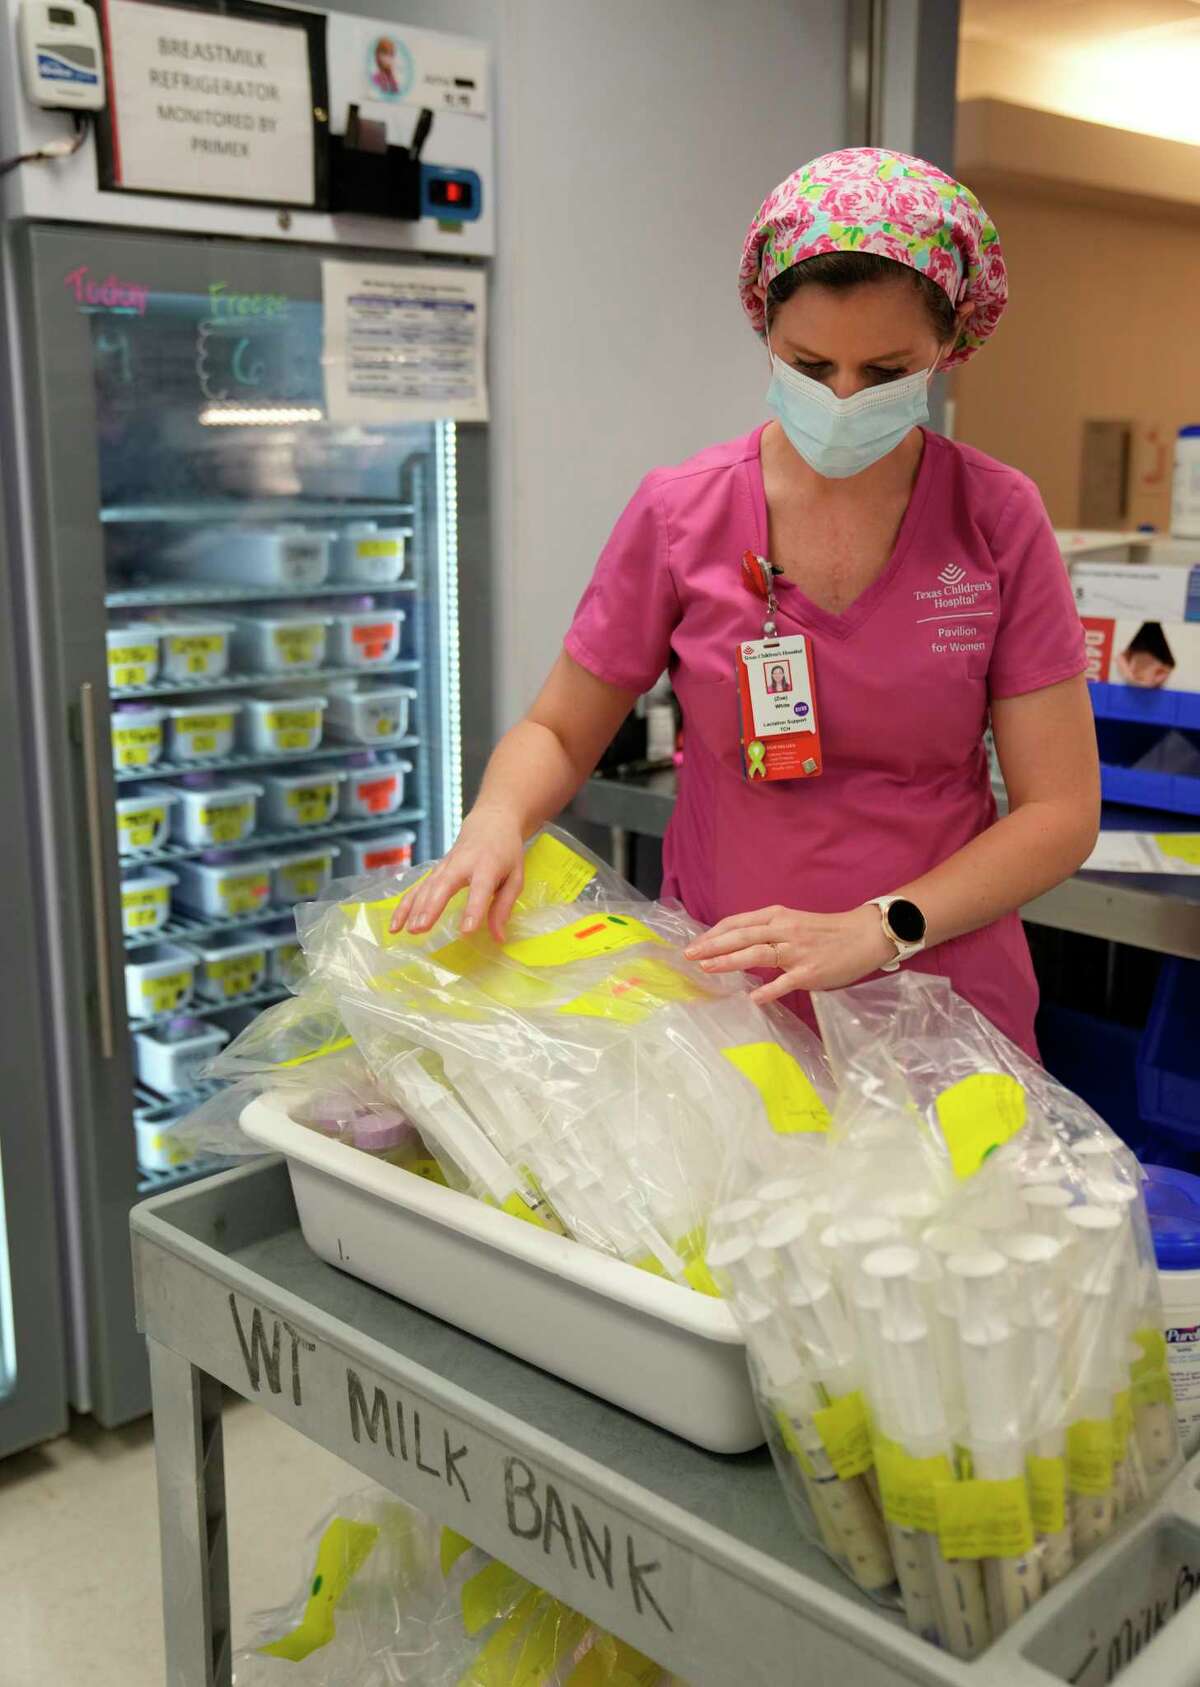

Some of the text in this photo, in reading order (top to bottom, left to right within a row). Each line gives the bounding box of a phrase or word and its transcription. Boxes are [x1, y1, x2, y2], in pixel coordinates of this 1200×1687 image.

[157, 37, 266, 69] BREASTMILK
[148, 68, 280, 101] REFRIGERATOR
[156, 104, 278, 133] MONITORED BY
[190, 136, 250, 157] PRIMEX
[914, 581, 992, 601] Texas Children's
[934, 593, 978, 609] Hospital
[938, 625, 978, 638] Pavilion
[931, 642, 986, 653] for Women
[228, 1292, 316, 1406] WT
[346, 1368, 472, 1503] MILK
[503, 1456, 675, 1633] BANK
